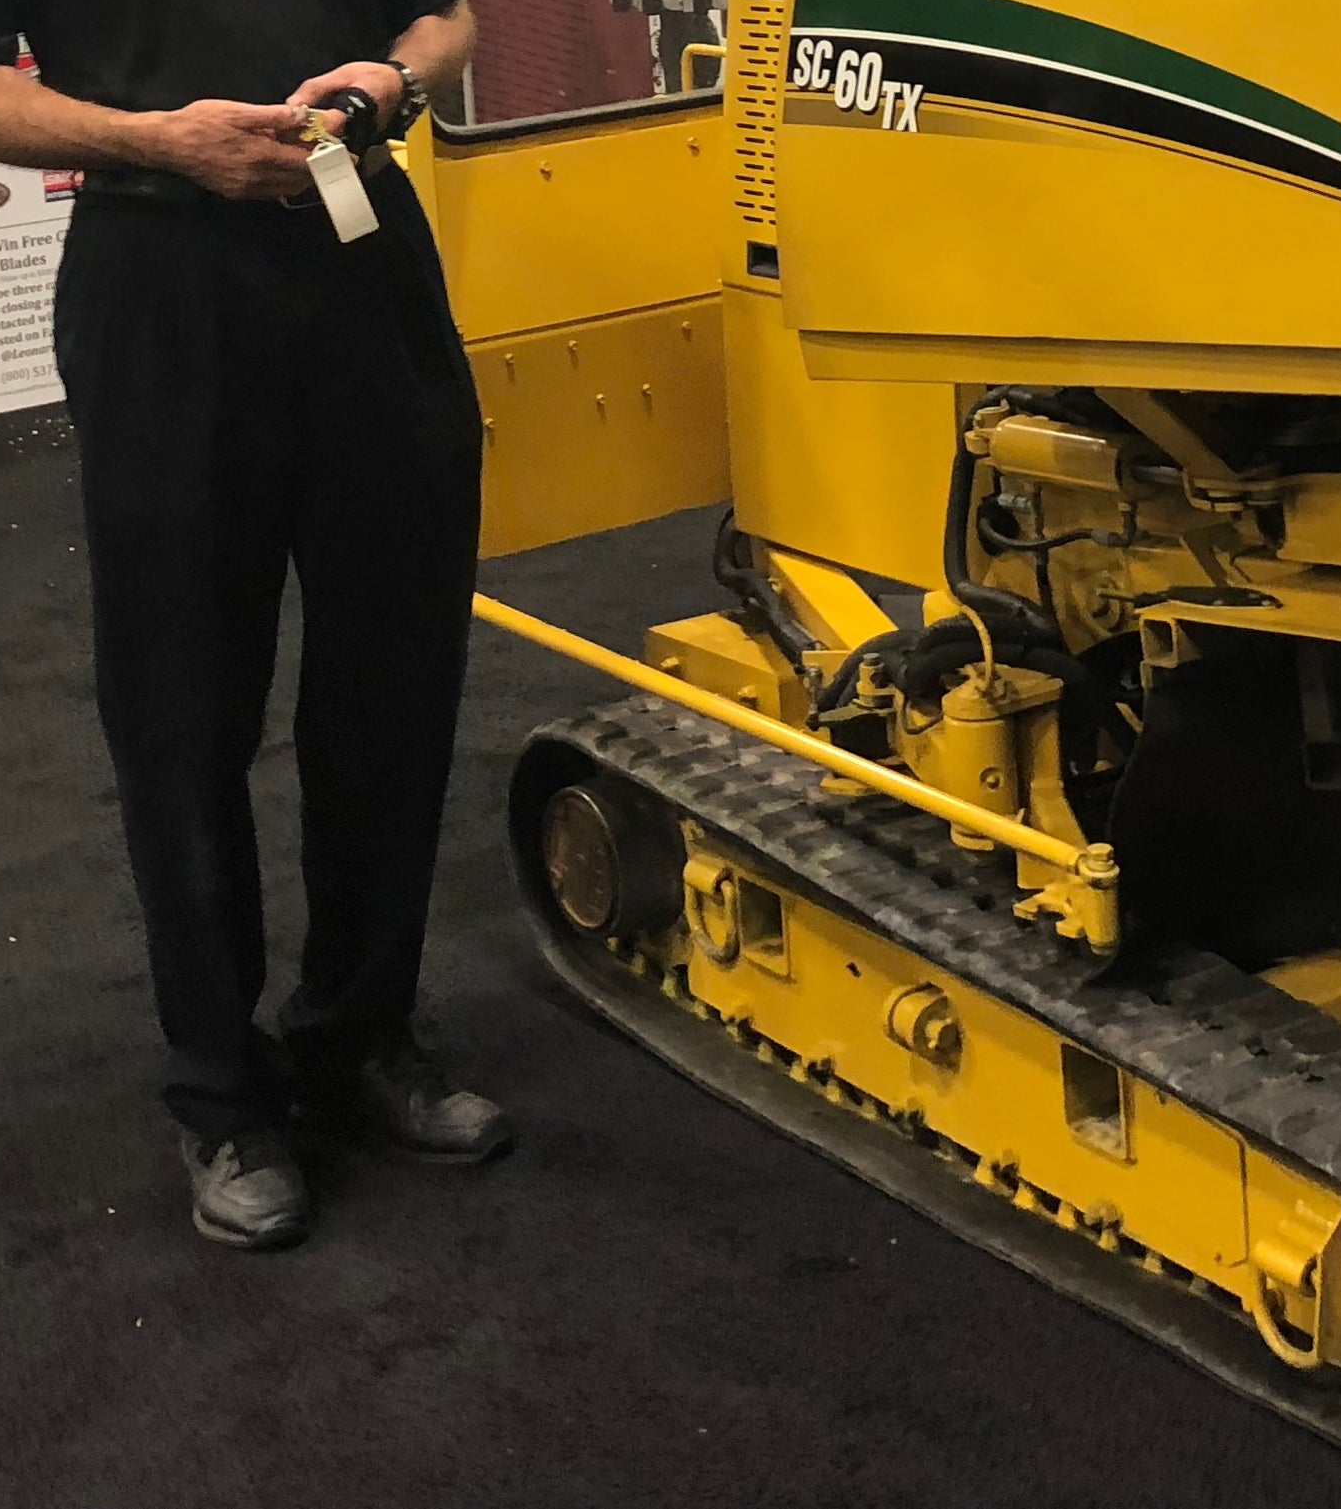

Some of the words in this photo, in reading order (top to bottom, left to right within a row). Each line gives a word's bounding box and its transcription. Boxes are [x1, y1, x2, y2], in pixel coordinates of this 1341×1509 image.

[21, 234, 53, 249] Free
[0, 254, 47, 272] Blades
[12, 283, 43, 296] three
[1, 298, 42, 311] closing
[24, 330, 40, 341] on
